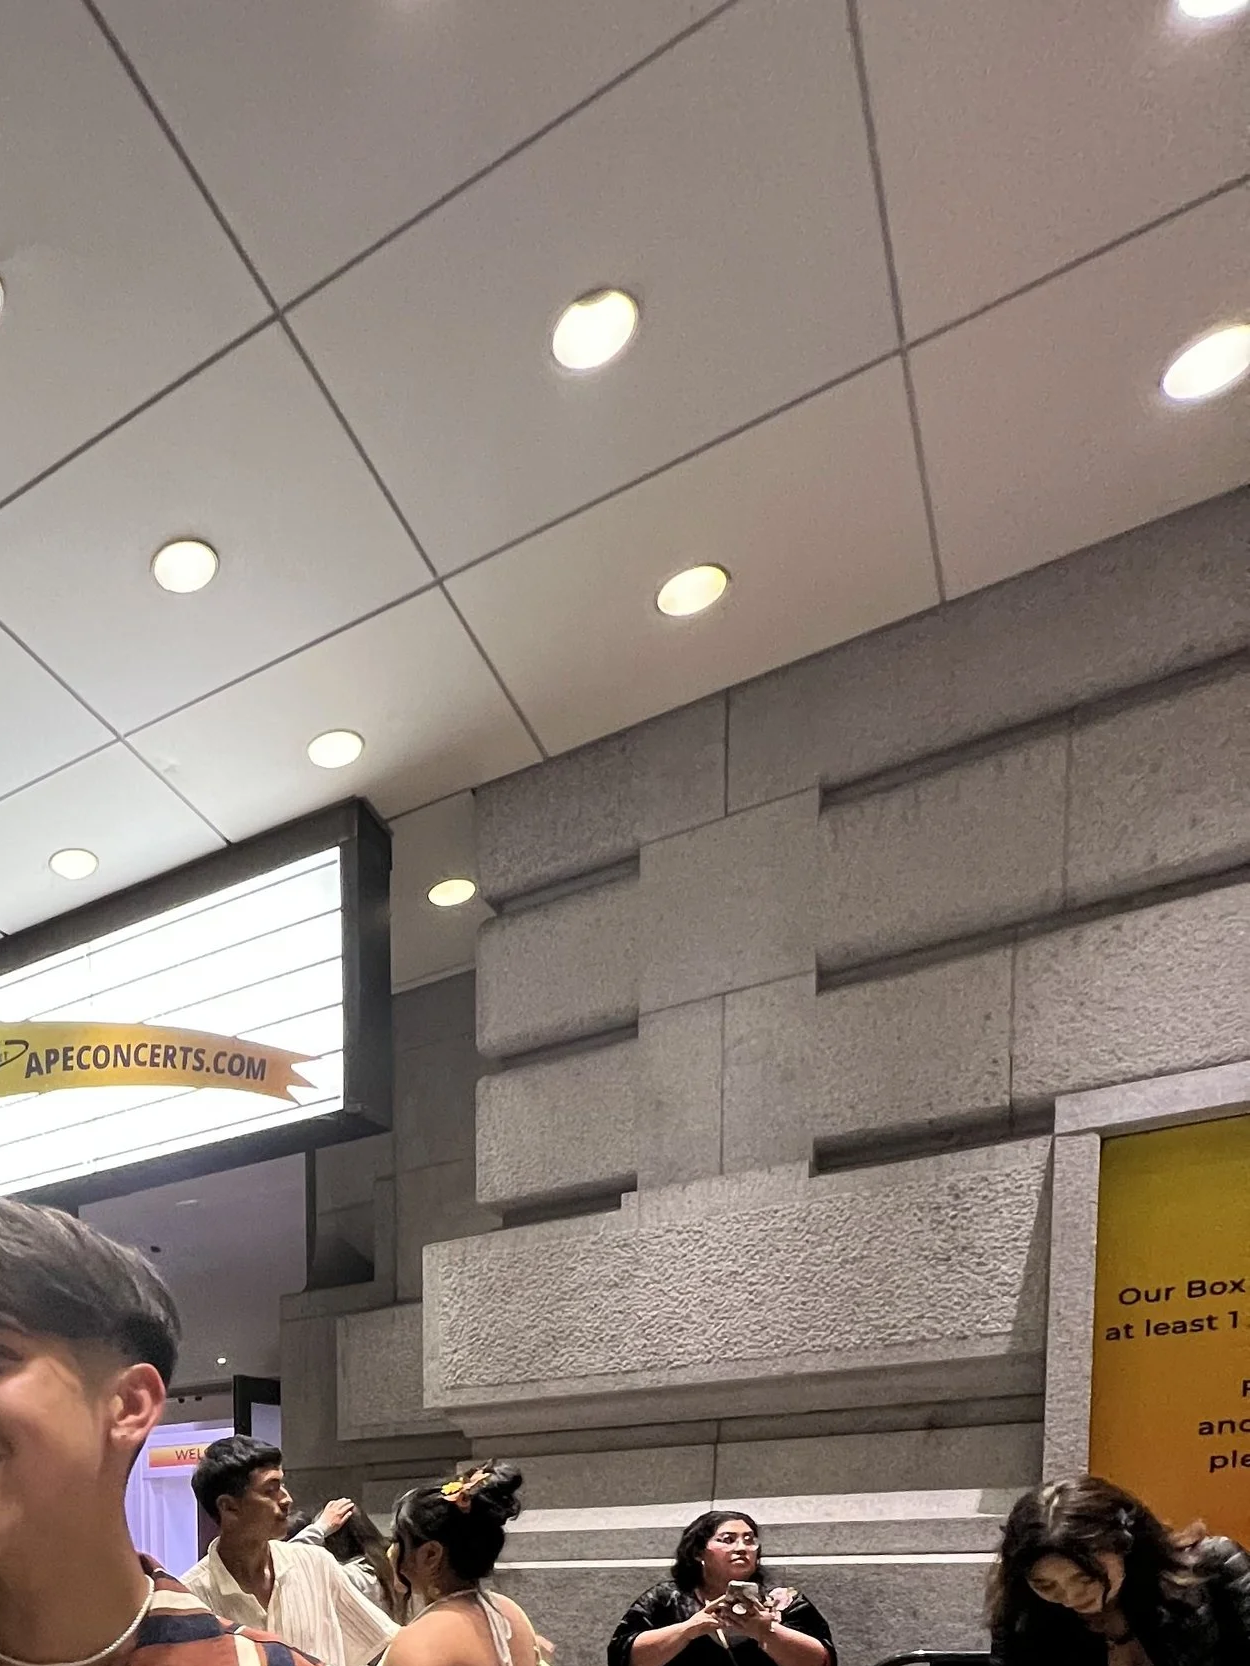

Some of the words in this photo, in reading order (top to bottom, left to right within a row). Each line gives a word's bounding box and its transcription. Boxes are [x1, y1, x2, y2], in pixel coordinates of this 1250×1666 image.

[25, 1043, 267, 1082] APECONCERTS.COM
[1118, 1286, 1176, 1306] Our
[1187, 1278, 1246, 1299] Box
[1105, 1323, 1135, 1341] at
[1145, 1314, 1219, 1337] least
